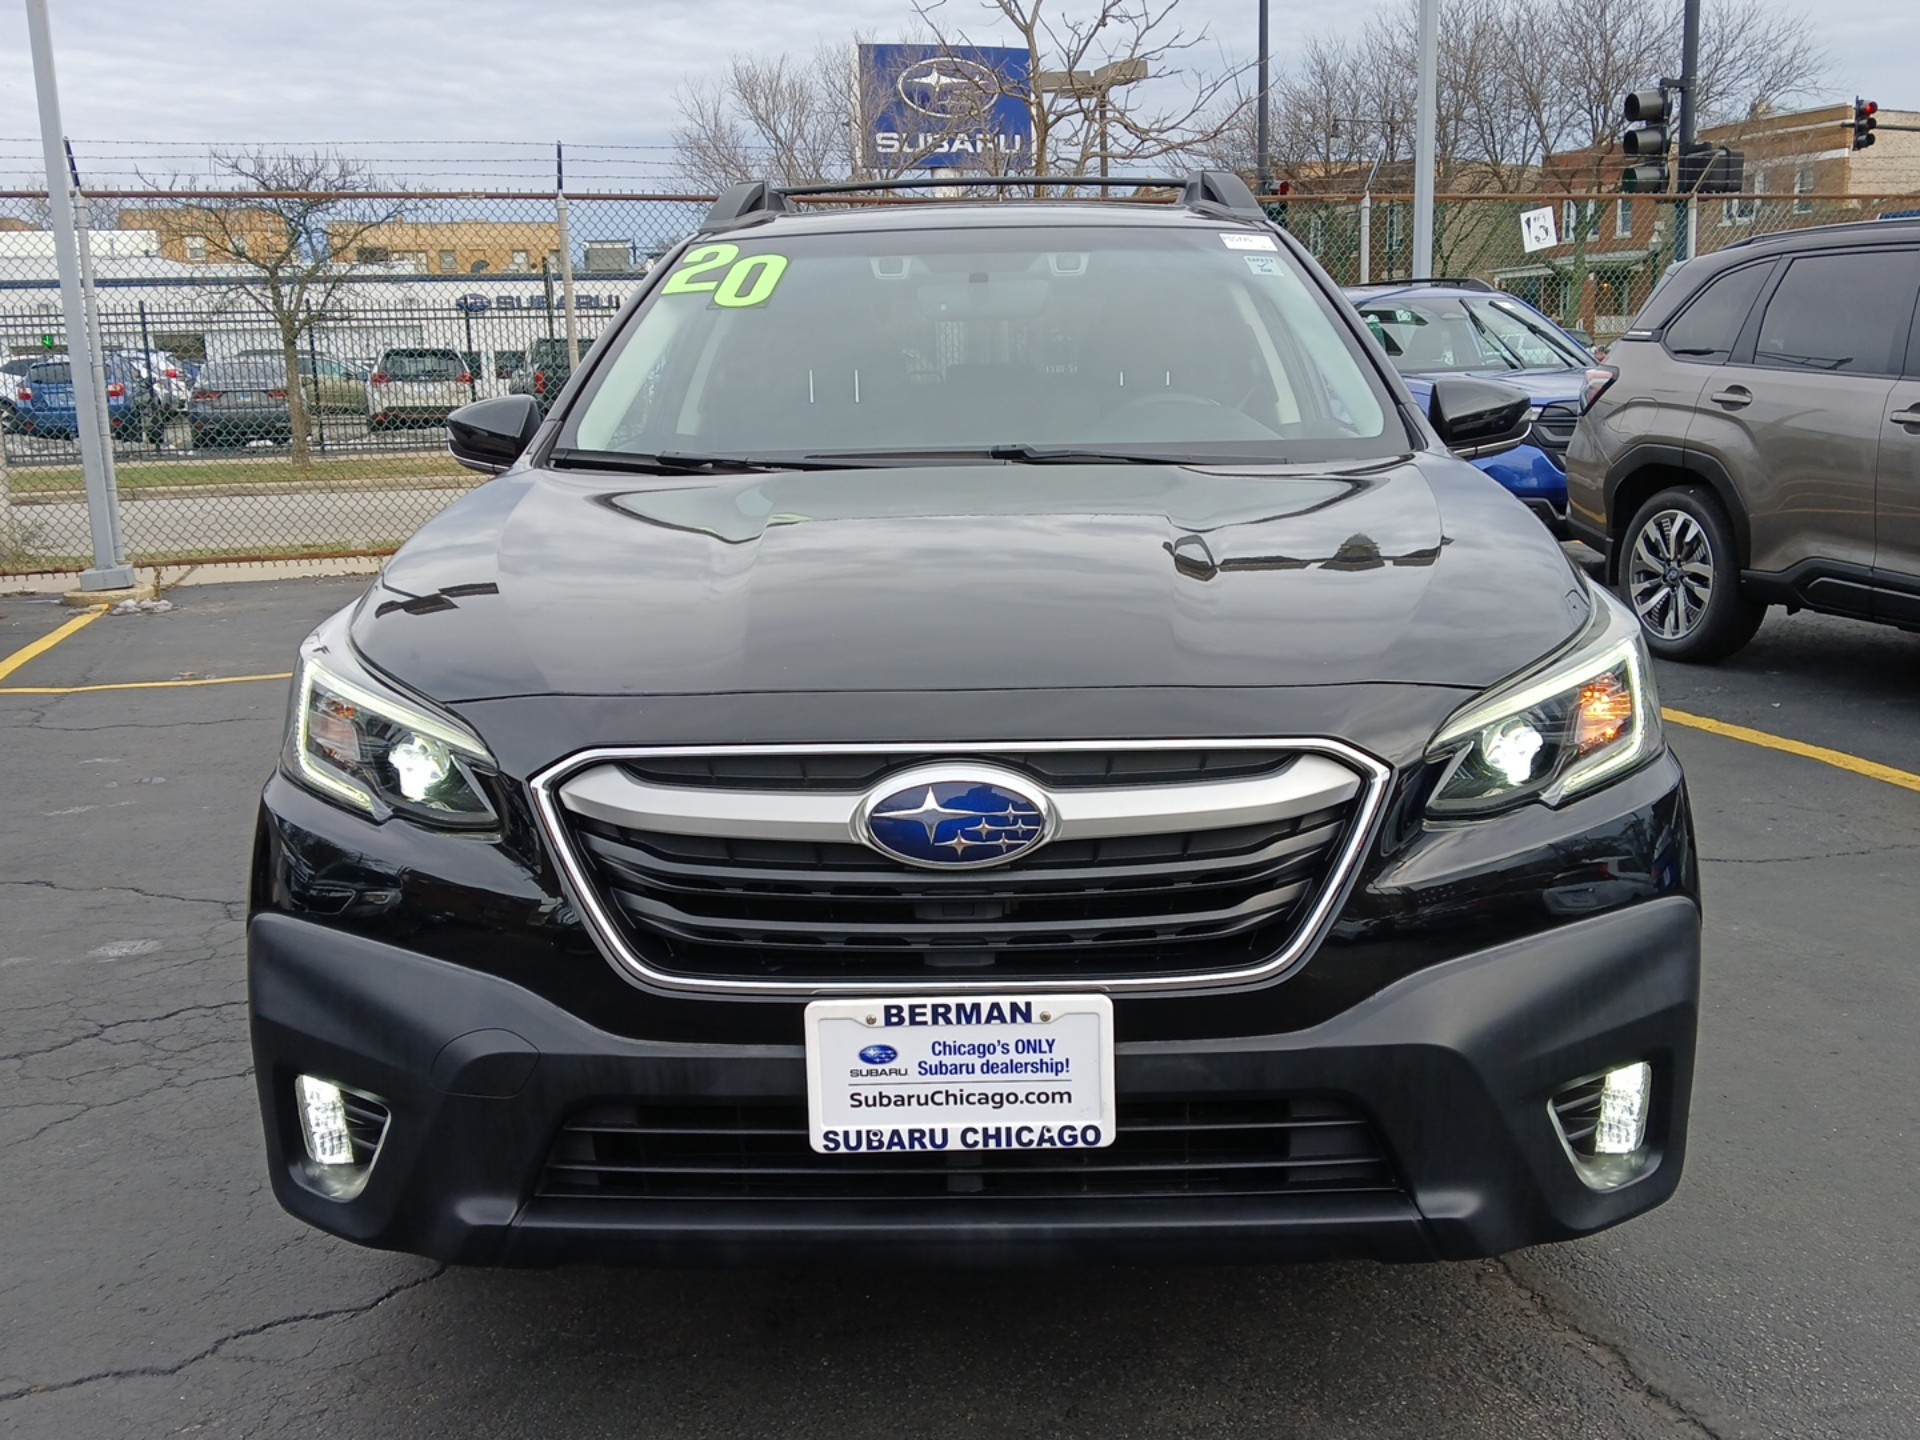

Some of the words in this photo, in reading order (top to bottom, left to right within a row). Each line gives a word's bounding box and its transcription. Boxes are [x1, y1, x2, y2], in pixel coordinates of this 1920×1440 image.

[875, 132, 1021, 153] SUBARU
[660, 243, 788, 307] 20
[884, 1002, 1032, 1026] BERMAN
[931, 1040, 1010, 1058] Chicago's
[1014, 1038, 1056, 1055] ONLY
[849, 1068, 908, 1078] SUBARU
[917, 1060, 976, 1076] Subaru
[980, 1058, 1070, 1077] dealership!
[849, 1088, 1073, 1110] SubaruChicago.com
[822, 1128, 949, 1152] SUBARU
[960, 1125, 1101, 1149] CHICAGO
